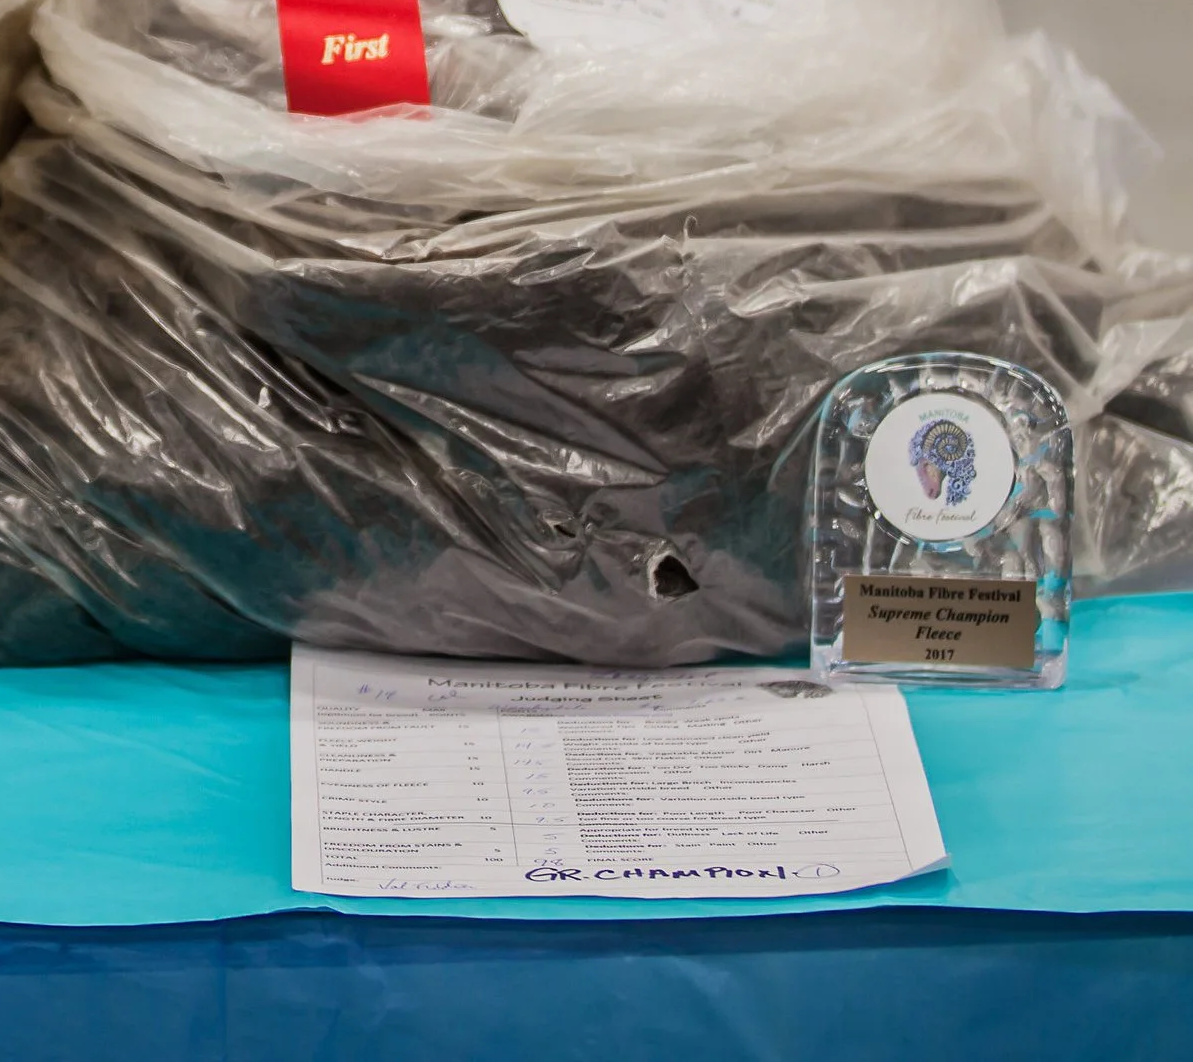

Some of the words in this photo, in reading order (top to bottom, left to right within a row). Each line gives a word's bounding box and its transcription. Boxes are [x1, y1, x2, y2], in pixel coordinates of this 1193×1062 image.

[321, 33, 389, 65] First
[860, 584, 924, 599] Manitoba
[928, 586, 964, 600] Fibre
[969, 587, 1021, 602] Festival
[868, 605, 931, 622] Supreme
[935, 607, 1009, 626] Champion
[915, 626, 962, 641] Fleece
[925, 649, 954, 660] 2017
[428, 677, 555, 690] Manitoba
[510, 695, 593, 704] Judging
